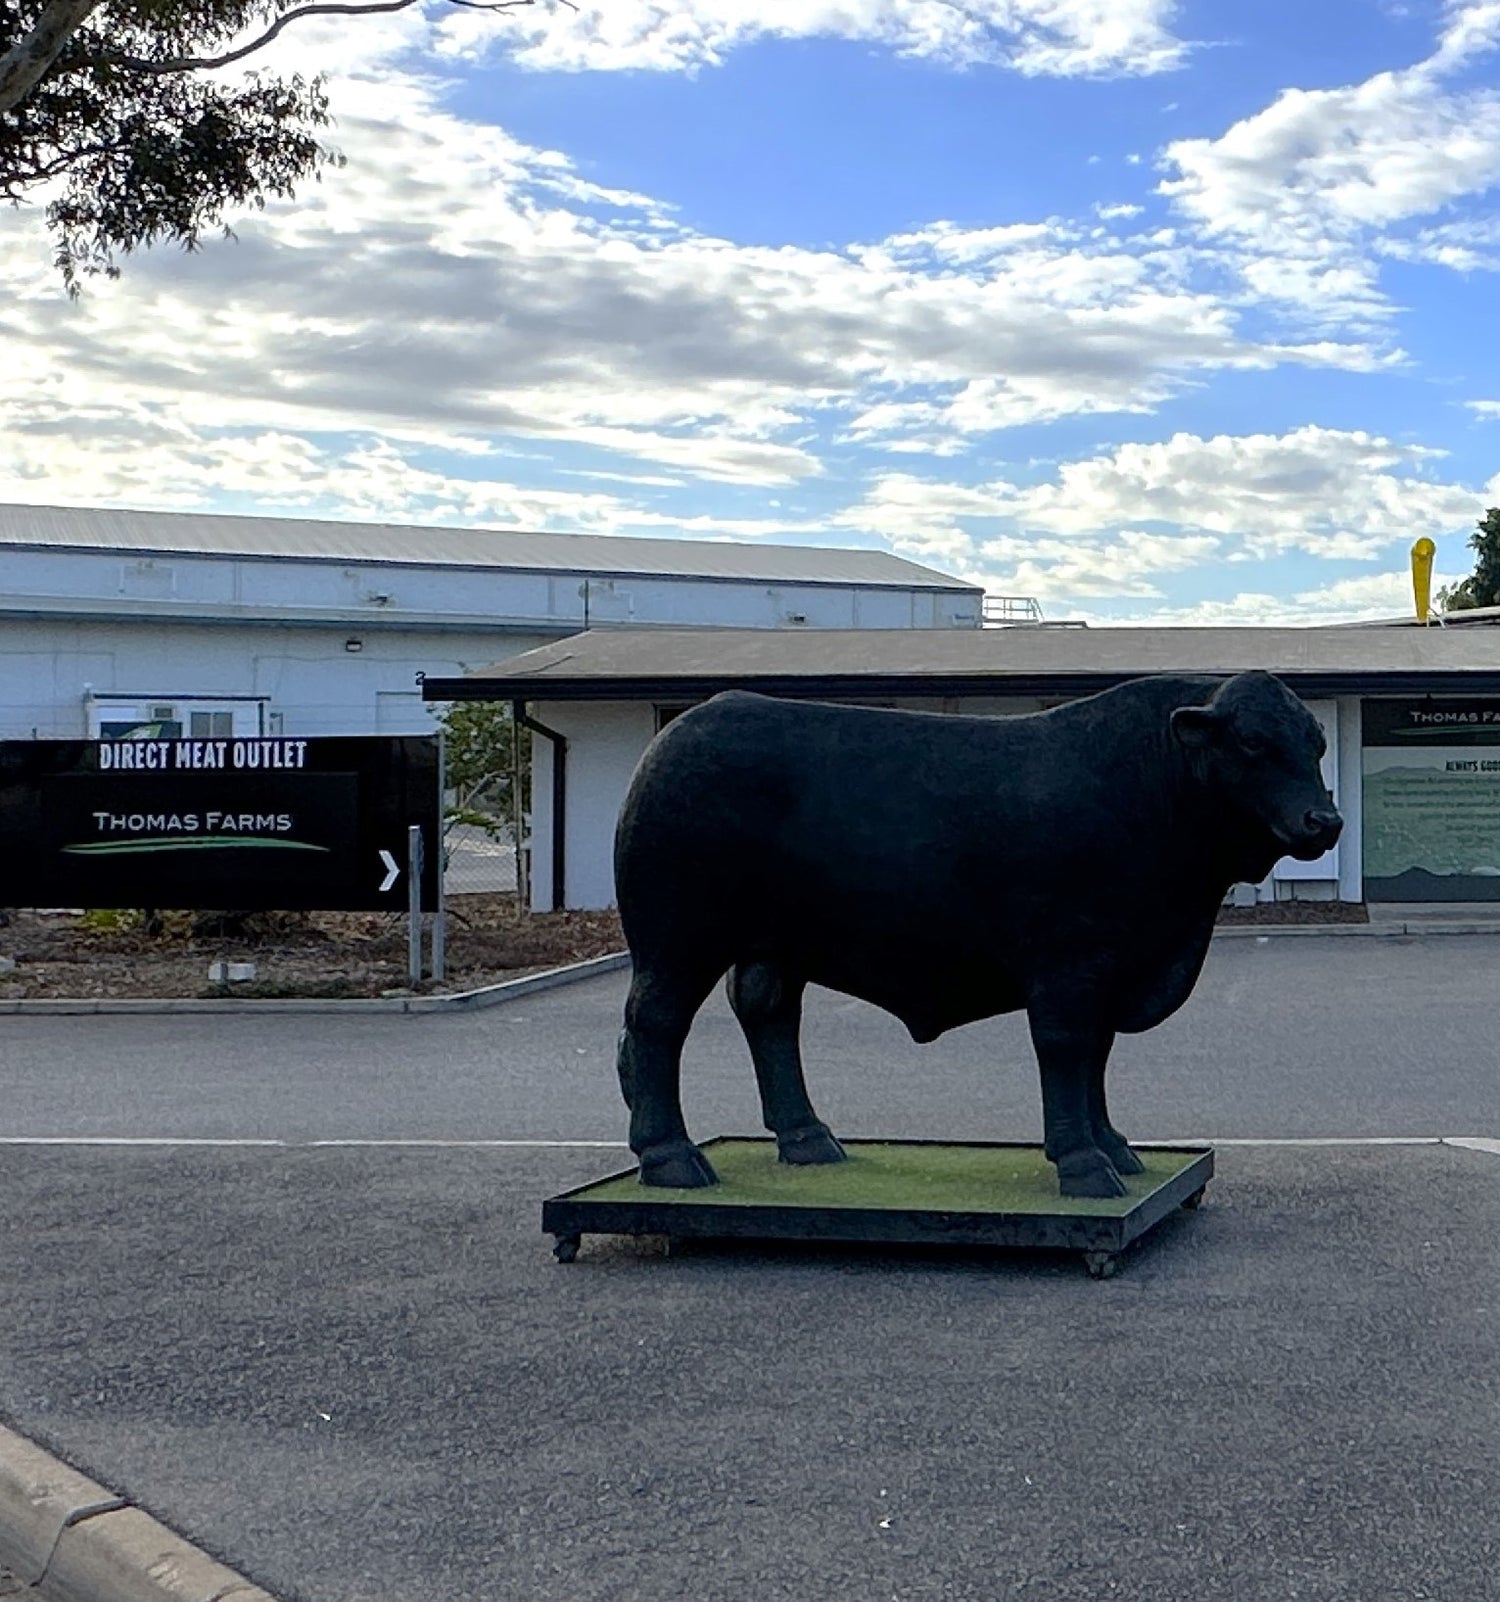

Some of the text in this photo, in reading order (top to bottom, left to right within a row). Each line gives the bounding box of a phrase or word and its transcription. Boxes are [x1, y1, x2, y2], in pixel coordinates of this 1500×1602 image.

[1410, 711, 1478, 723] THOMAS
[99, 741, 308, 769] DIRECT MEAT OUTLET
[93, 811, 292, 831] THOMAS FARMS
